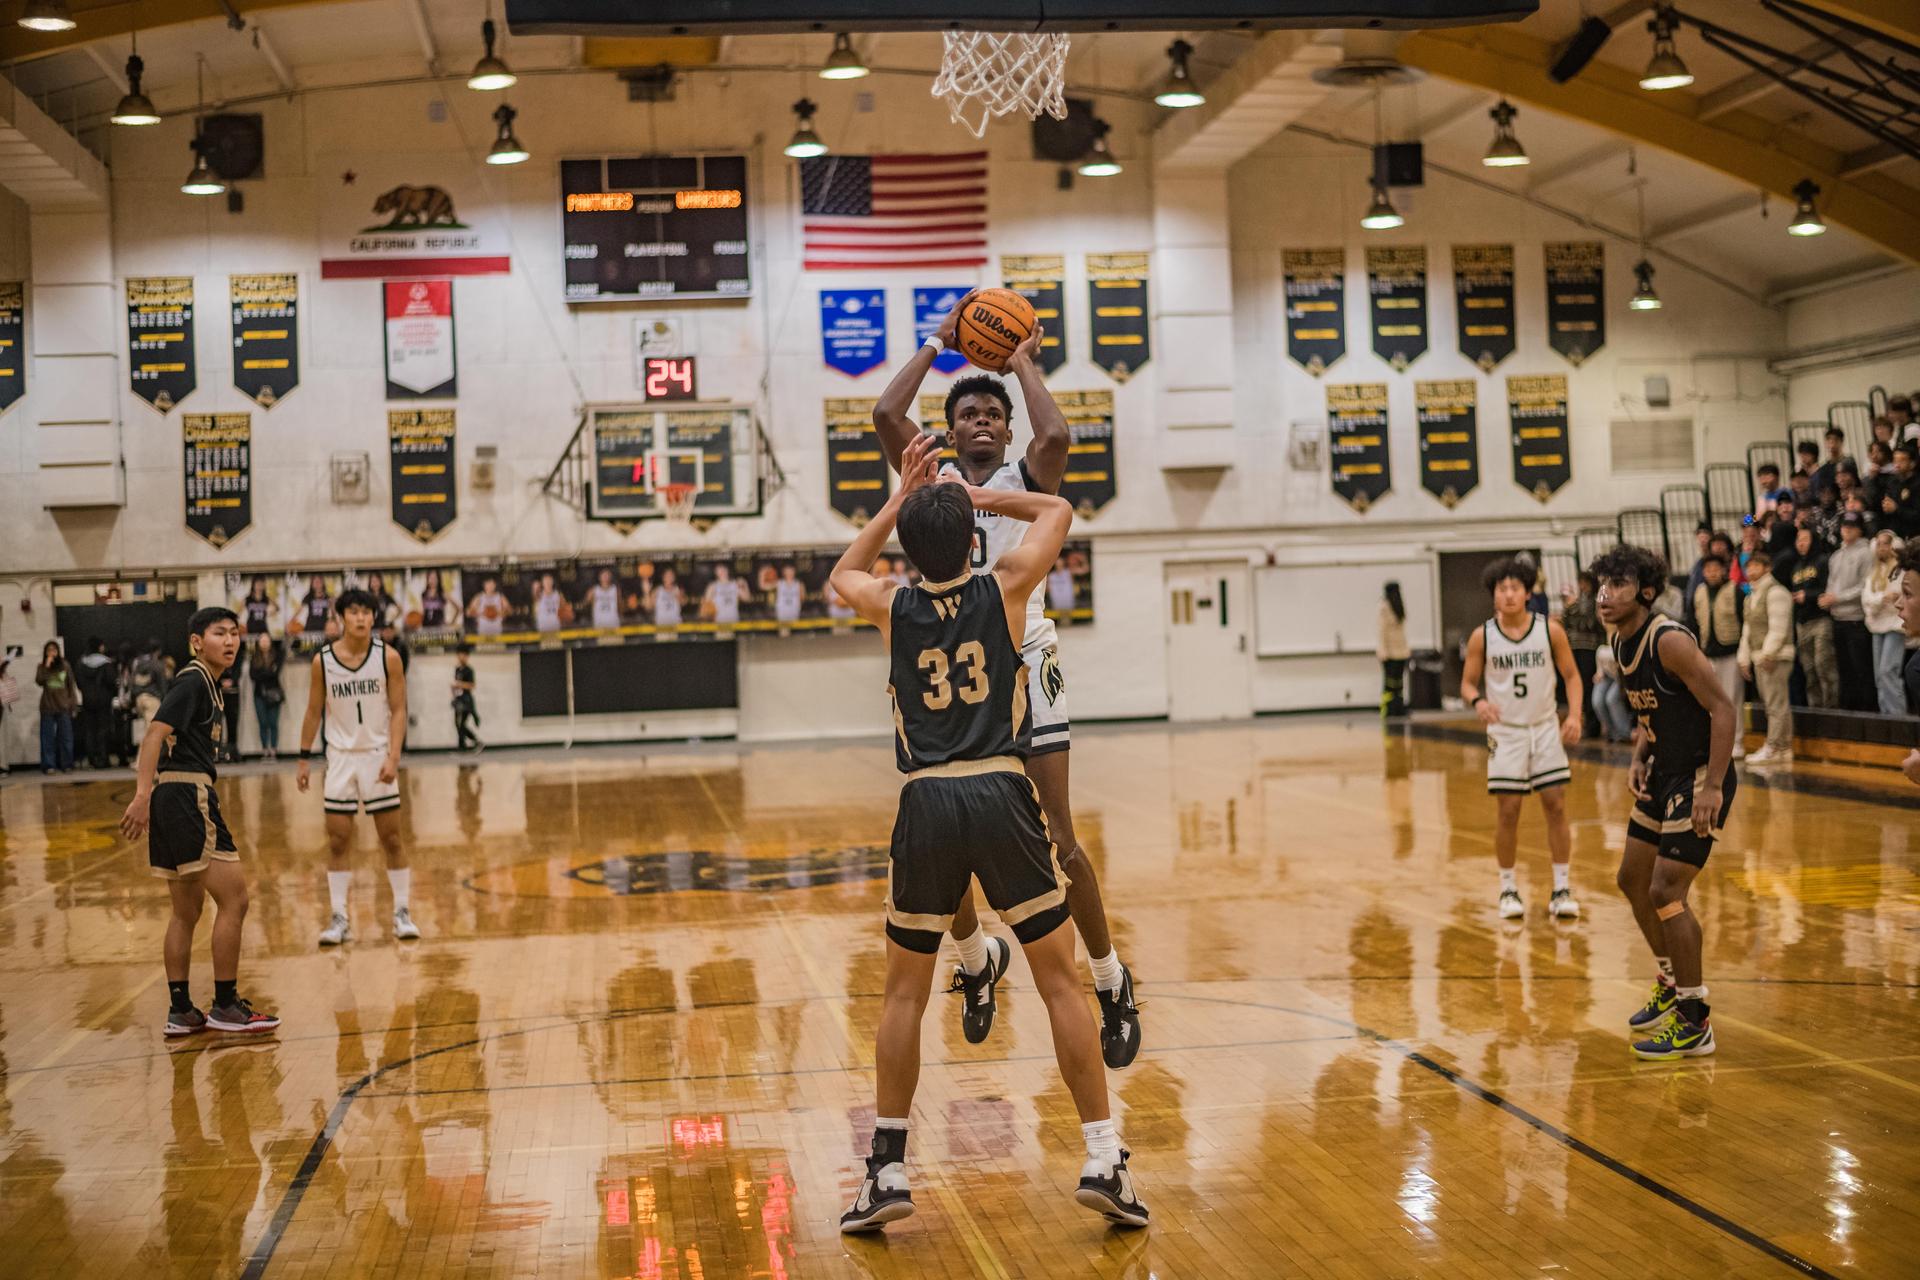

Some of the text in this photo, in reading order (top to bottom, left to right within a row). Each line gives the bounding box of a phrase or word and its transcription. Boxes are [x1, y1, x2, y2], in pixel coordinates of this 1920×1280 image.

[567, 193, 633, 212] PANTHERS
[676, 190, 741, 209] WARRIORS
[350, 236, 479, 252] CALIFORNIA REPUBLIC
[972, 305, 1021, 346] Wilson
[647, 360, 691, 396] 24
[1492, 650, 1545, 669] PANTHERS
[918, 640, 990, 711] 33
[1513, 673, 1528, 699] 5
[332, 678, 380, 699] PANTHERS
[356, 700, 363, 724] 1
